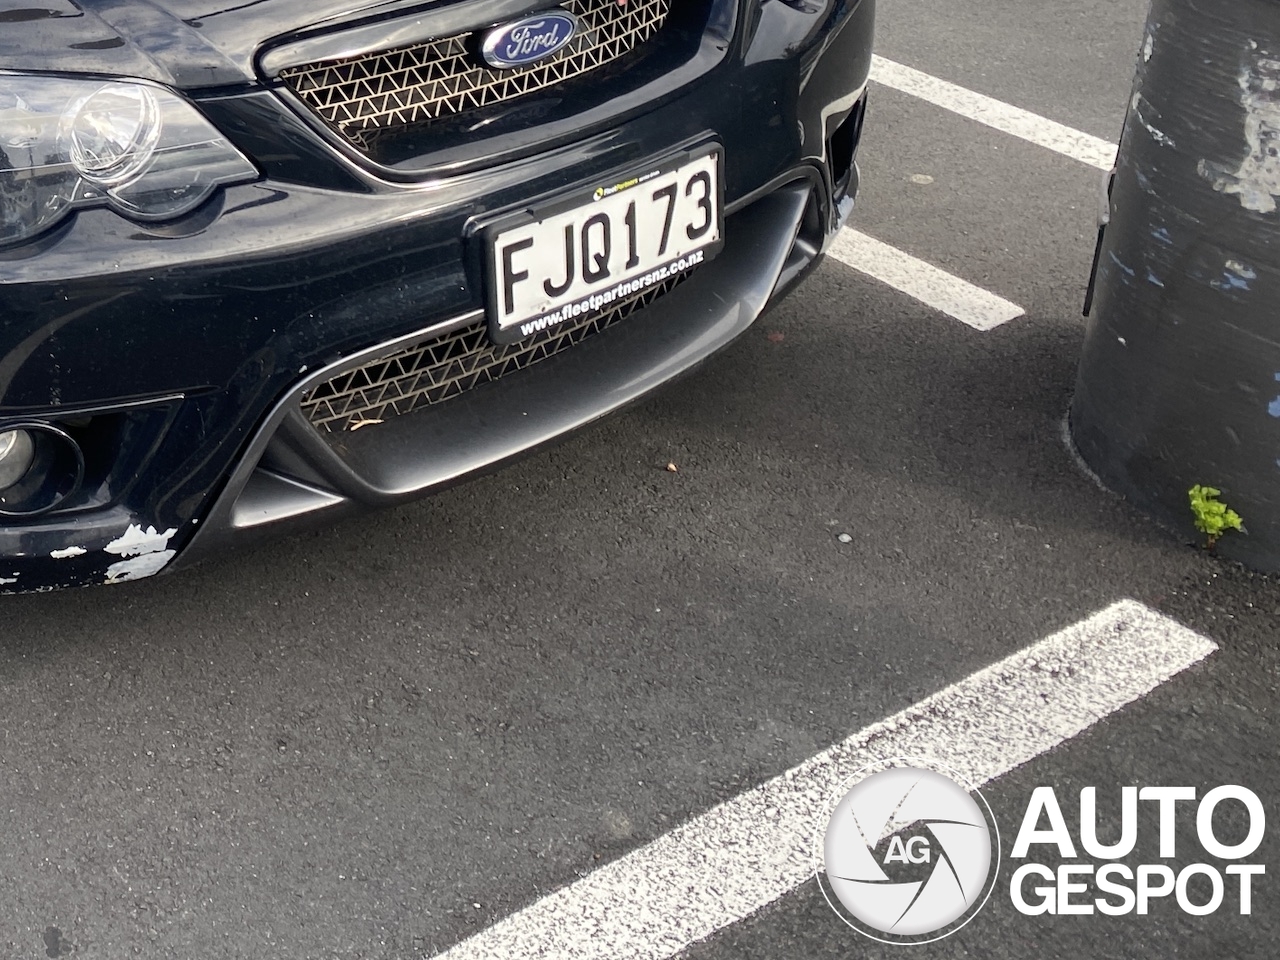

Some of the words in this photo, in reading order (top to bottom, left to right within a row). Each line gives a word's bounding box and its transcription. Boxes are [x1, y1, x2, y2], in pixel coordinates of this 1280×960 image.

[505, 20, 560, 60] Ford
[502, 170, 713, 316] FJQ173
[520, 249, 705, 337] www.fleetpartnersnz.co.nz
